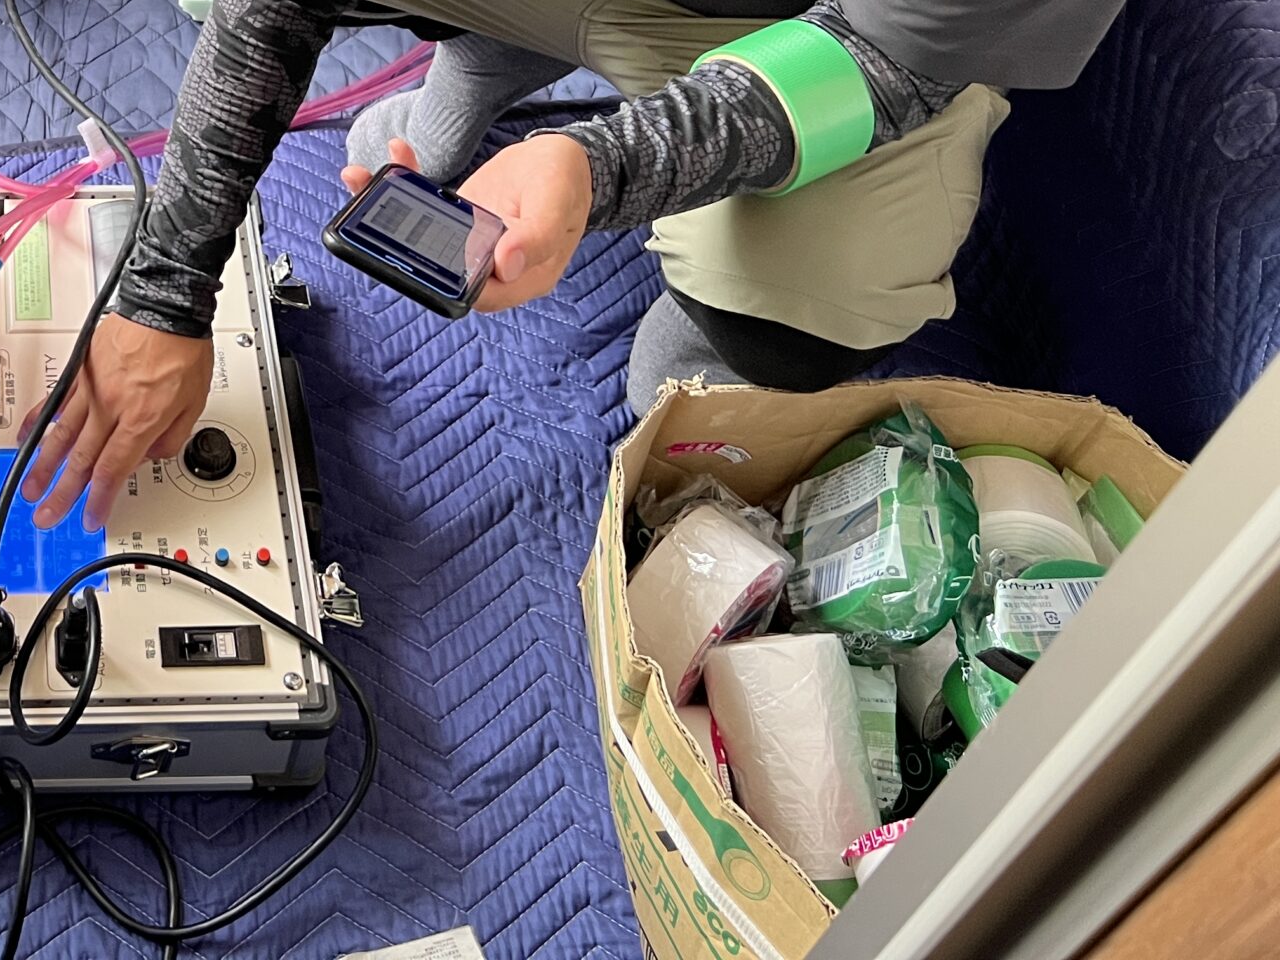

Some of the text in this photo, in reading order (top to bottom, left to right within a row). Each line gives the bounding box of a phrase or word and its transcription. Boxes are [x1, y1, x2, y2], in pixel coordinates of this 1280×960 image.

[43, 353, 58, 396] NITY
[132, 531, 143, 550] 手動
[118, 538, 132, 587] 測定ード
[242, 551, 253, 570] 停止
[136, 573, 147, 593] 自動
